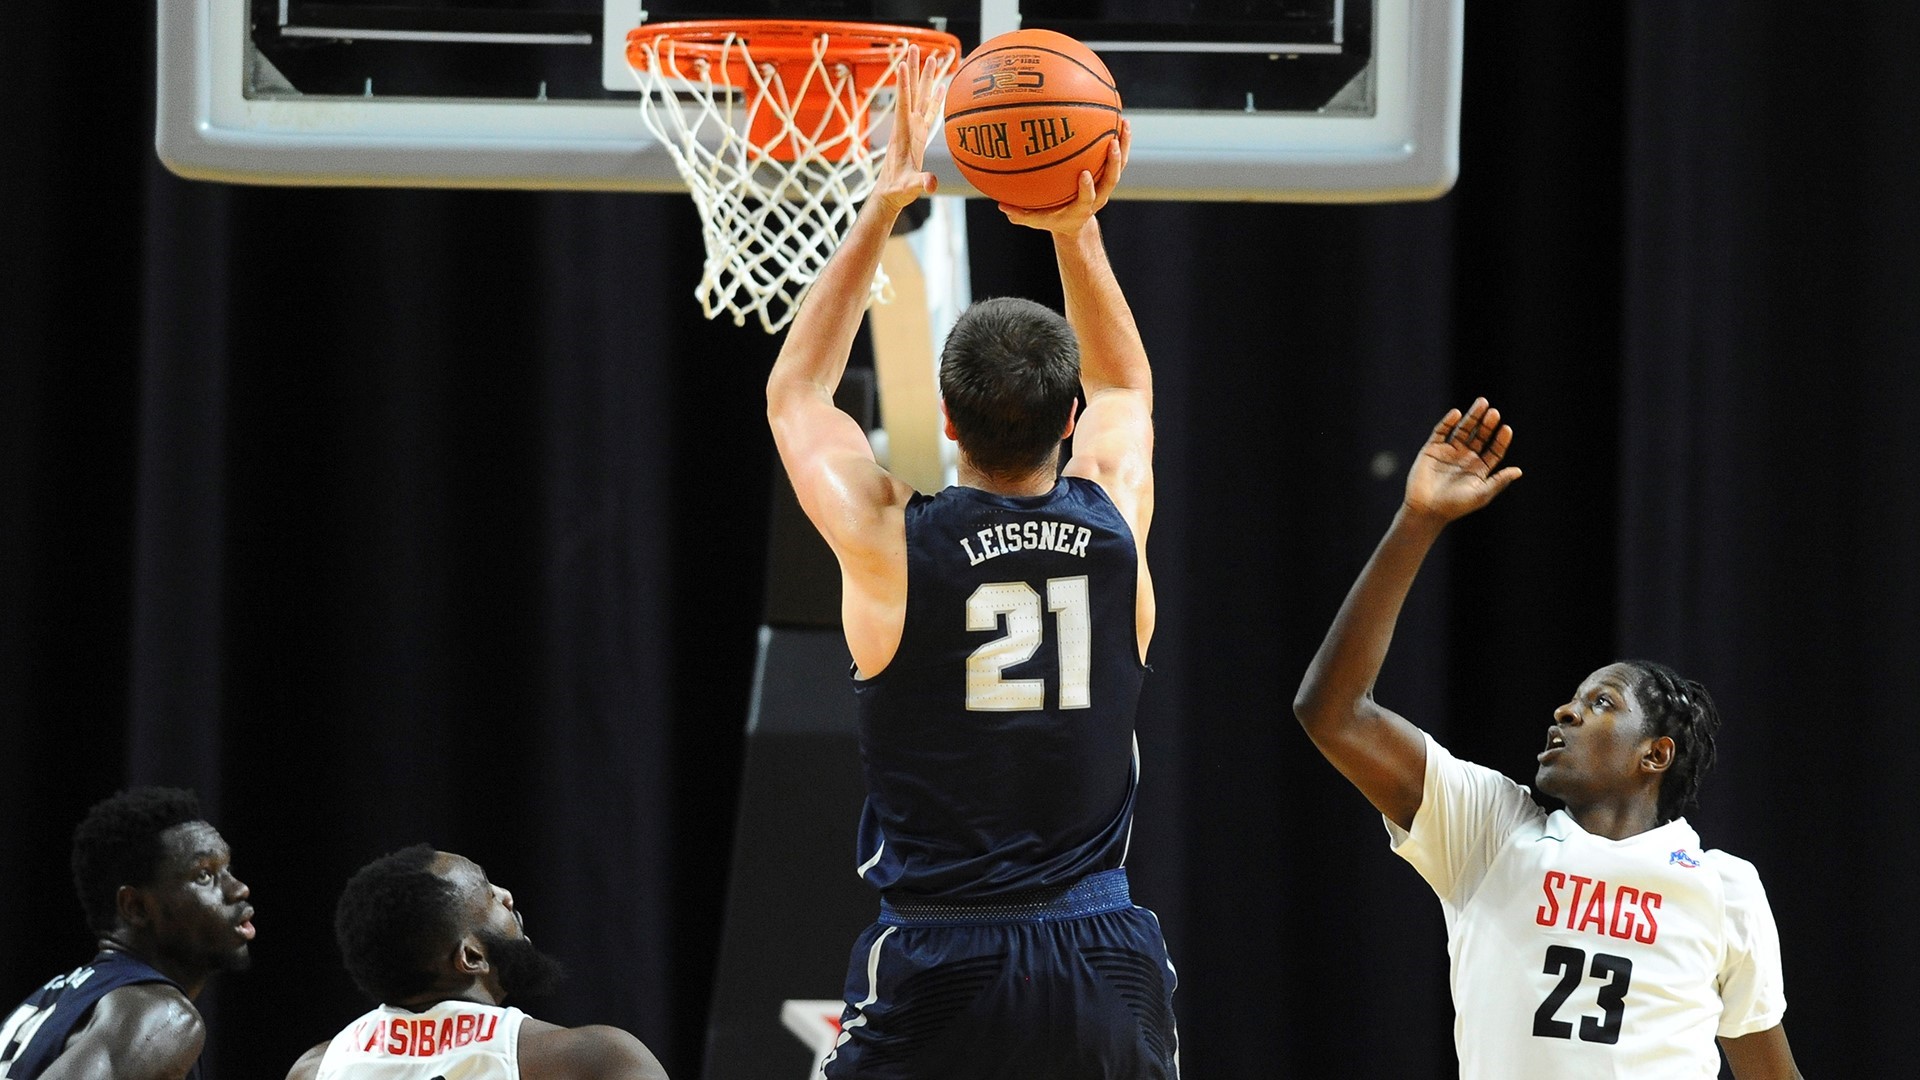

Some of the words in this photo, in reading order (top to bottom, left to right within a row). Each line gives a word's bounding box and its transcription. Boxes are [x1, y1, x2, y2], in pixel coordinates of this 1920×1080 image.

[956, 122, 1013, 159] ROCK
[1020, 117, 1075, 156] THE
[960, 520, 1092, 567] LEISSNER
[965, 574, 1092, 711] 21
[1536, 870, 1663, 945] STAGS
[1532, 944, 1633, 1045] 23
